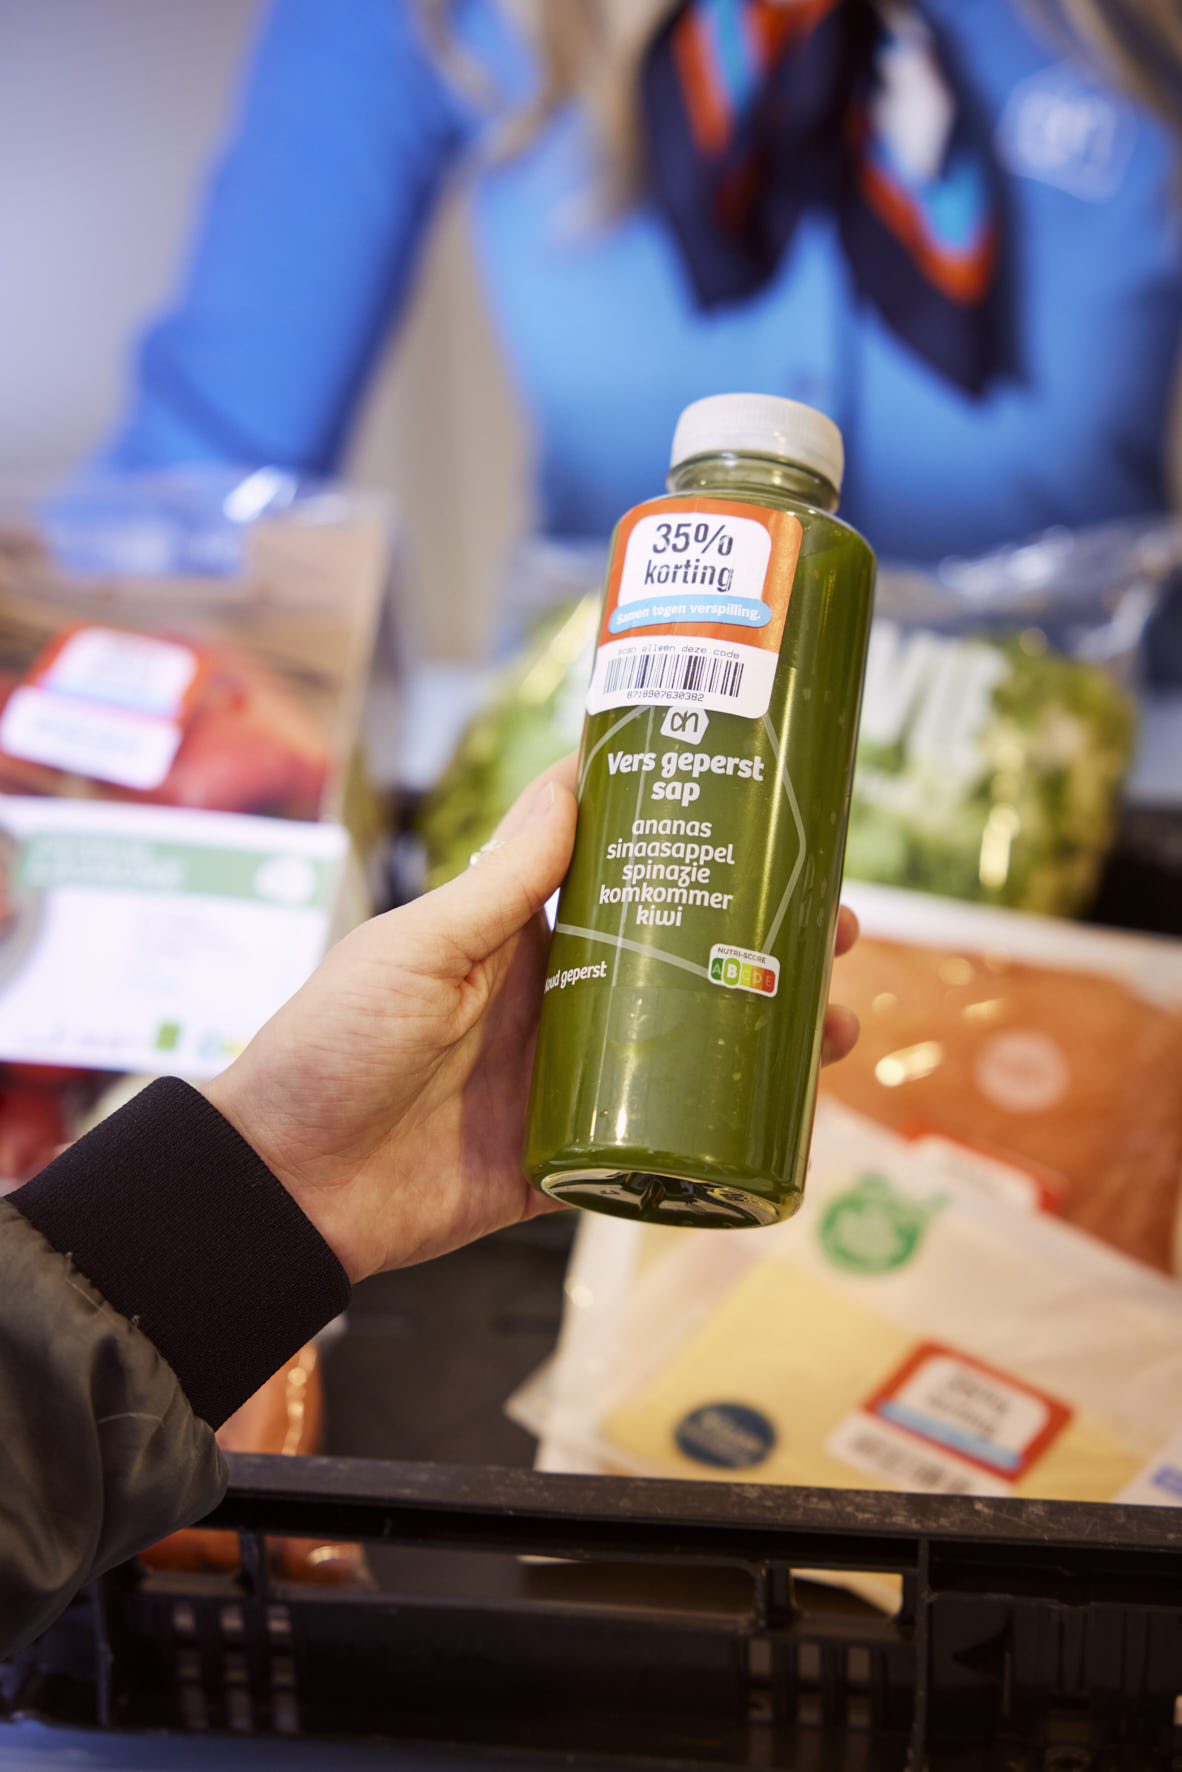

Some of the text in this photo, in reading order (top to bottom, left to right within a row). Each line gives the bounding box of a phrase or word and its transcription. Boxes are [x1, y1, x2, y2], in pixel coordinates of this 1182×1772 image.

[652, 523, 734, 556] 35%
[644, 558, 734, 592] korting
[616, 609, 649, 625] Samen
[652, 604, 686, 620] tegen
[641, 643, 676, 654] alleen
[681, 645, 708, 654] deze
[713, 647, 740, 660] code
[608, 750, 765, 780] Vers geperst
[651, 780, 700, 806] sap
[632, 818, 712, 838] ananas
[606, 838, 735, 864] sinaasappel
[622, 860, 710, 888] spinazie
[598, 884, 733, 910] komkommer
[636, 905, 682, 927] kiwi
[544, 960, 608, 994] oud geperst
